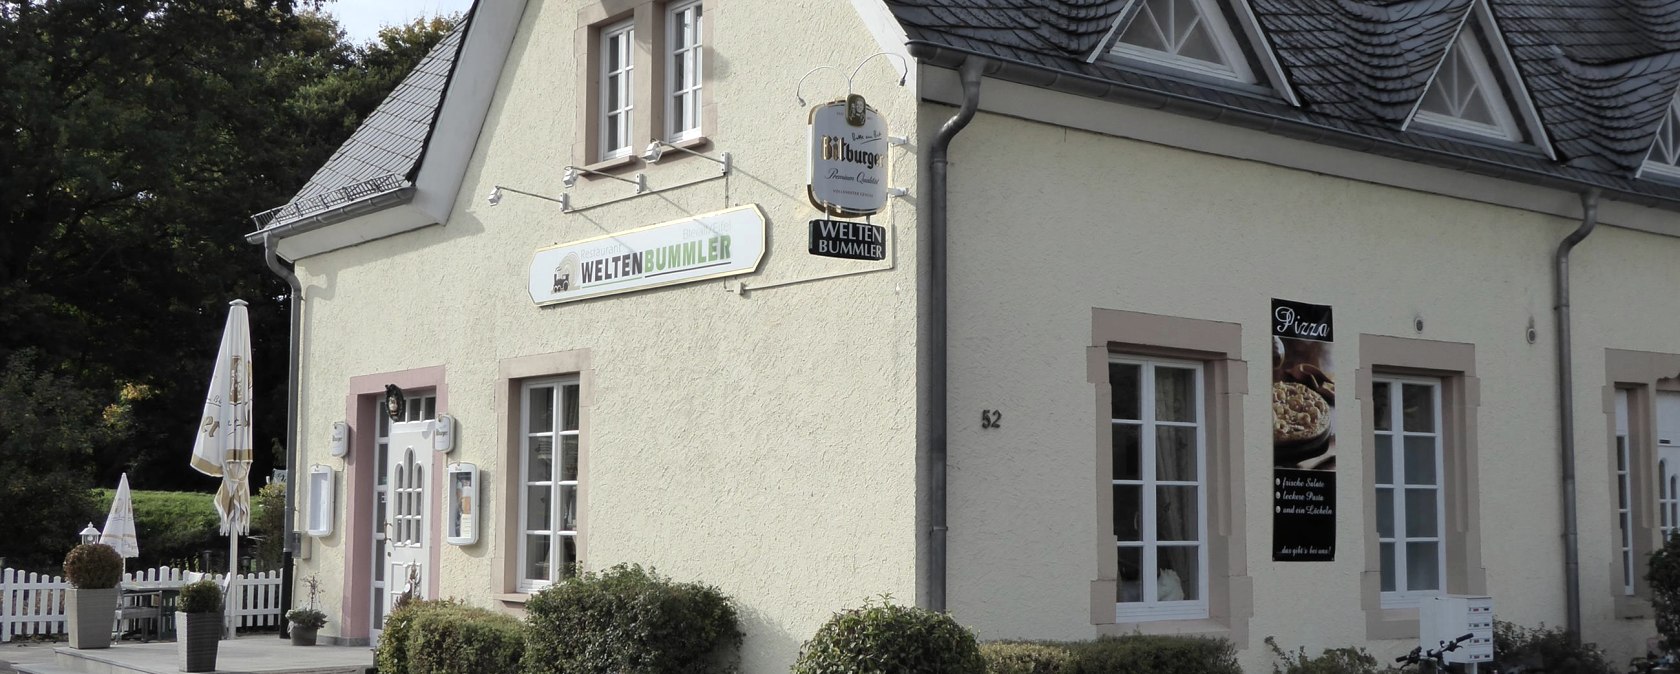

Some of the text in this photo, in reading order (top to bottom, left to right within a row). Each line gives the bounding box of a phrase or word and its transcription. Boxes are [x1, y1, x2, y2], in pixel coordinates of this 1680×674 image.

[822, 134, 884, 169] Bitburger
[825, 168, 854, 180] Premium
[819, 220, 882, 243] WELTEN
[581, 244, 621, 259] Restaurant
[819, 239, 882, 258] BUMMLER
[1275, 306, 1330, 337] Pizza
[982, 409, 1002, 429] 52
[1282, 505, 1295, 514] und
